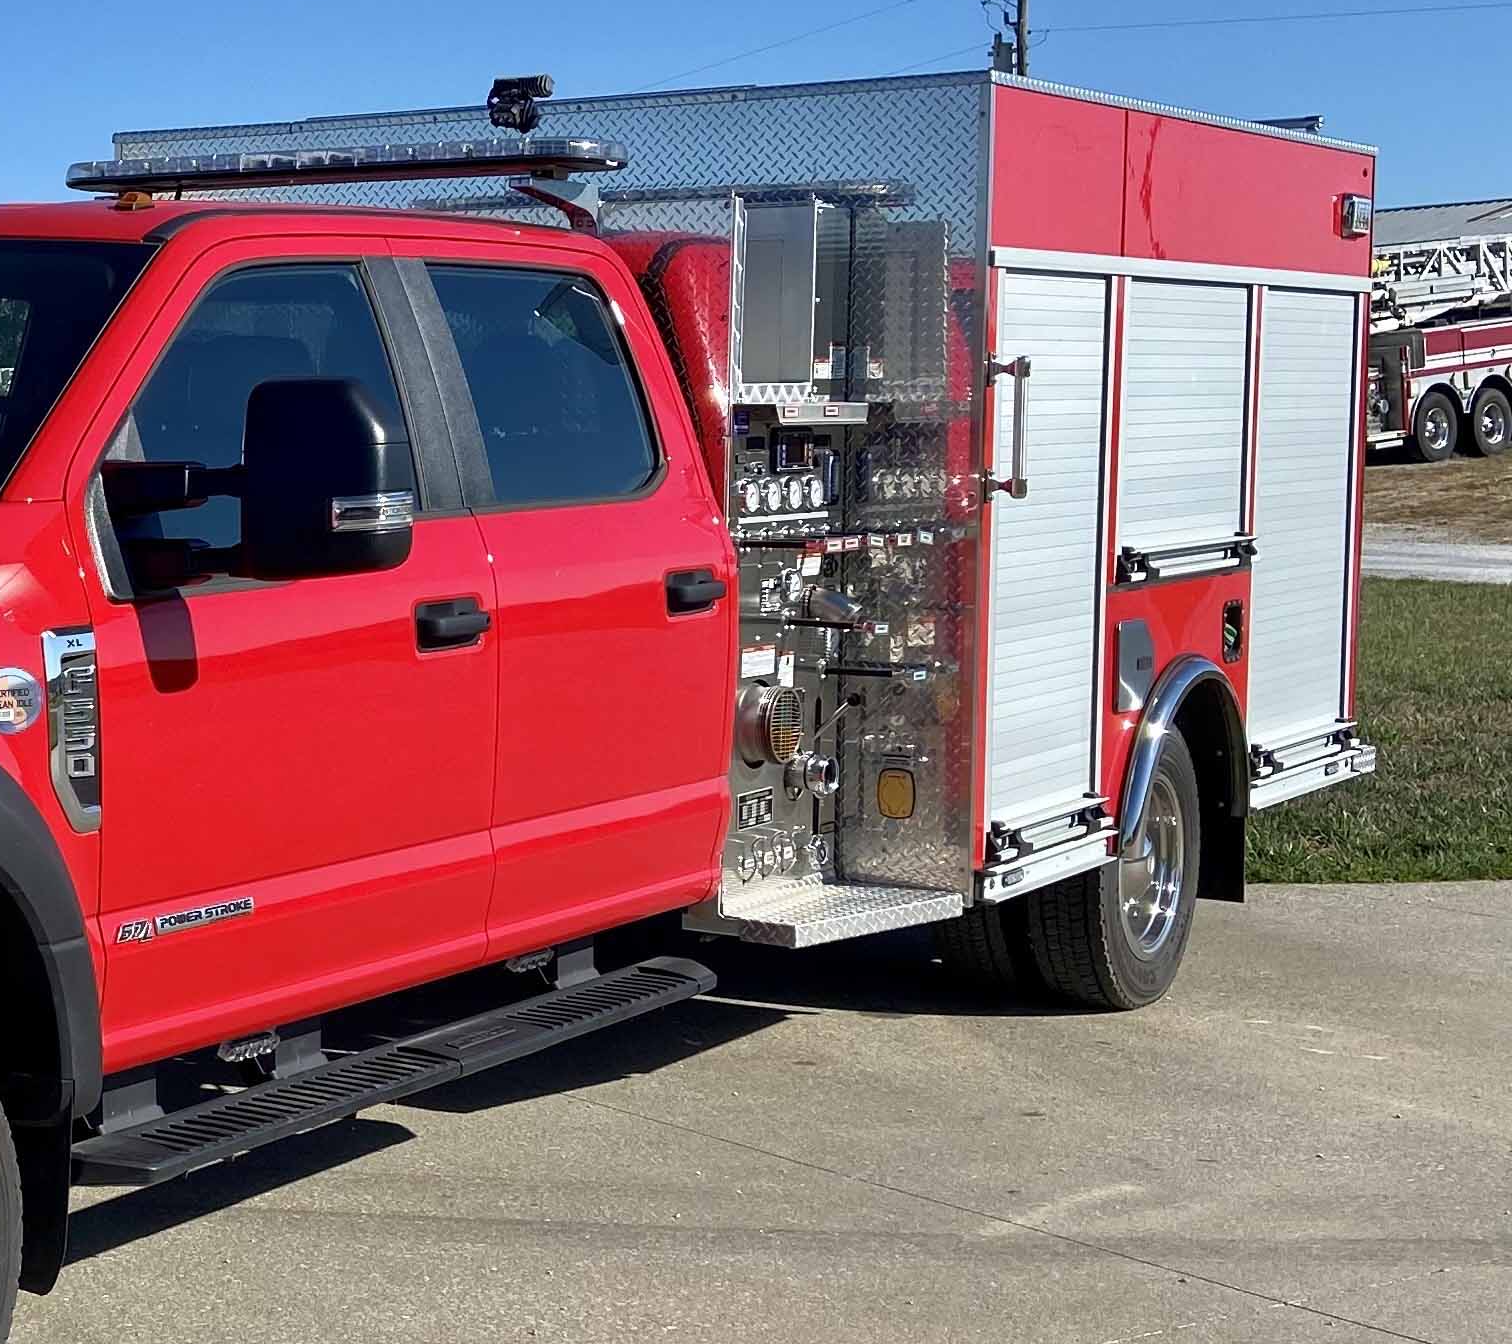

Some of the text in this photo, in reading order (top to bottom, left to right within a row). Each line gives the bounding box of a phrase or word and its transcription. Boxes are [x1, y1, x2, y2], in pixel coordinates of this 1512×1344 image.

[66, 639, 83, 648] XL
[16, 699, 33, 708] IDLE
[159, 910, 203, 929] POWER
[205, 899, 253, 919] STROKE
